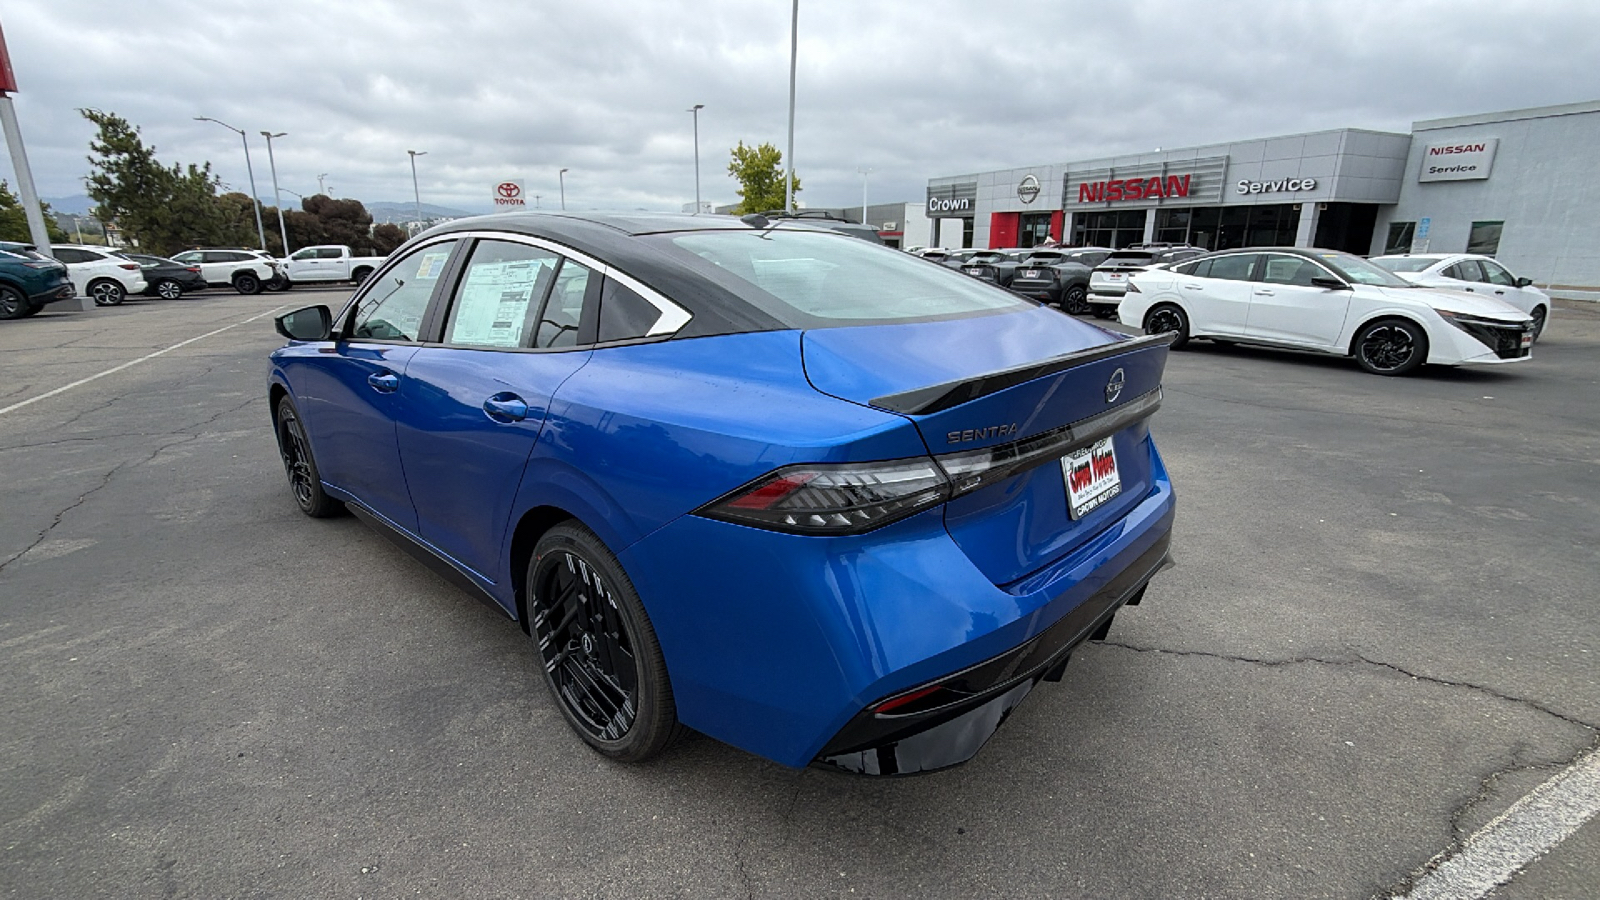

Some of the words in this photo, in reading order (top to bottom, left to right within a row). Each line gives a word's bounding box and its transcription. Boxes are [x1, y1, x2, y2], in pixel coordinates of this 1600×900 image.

[1429, 143, 1486, 156] NISSAN
[1429, 163, 1477, 174] Service
[1078, 173, 1191, 203] NISSAN
[1236, 177, 1316, 195] Service
[494, 198, 526, 206] TOYOTA
[929, 197, 969, 212] Crown
[947, 422, 1018, 444] SENTRA
[1077, 499, 1098, 516] CROWN
[1098, 484, 1119, 505] MOTORS
